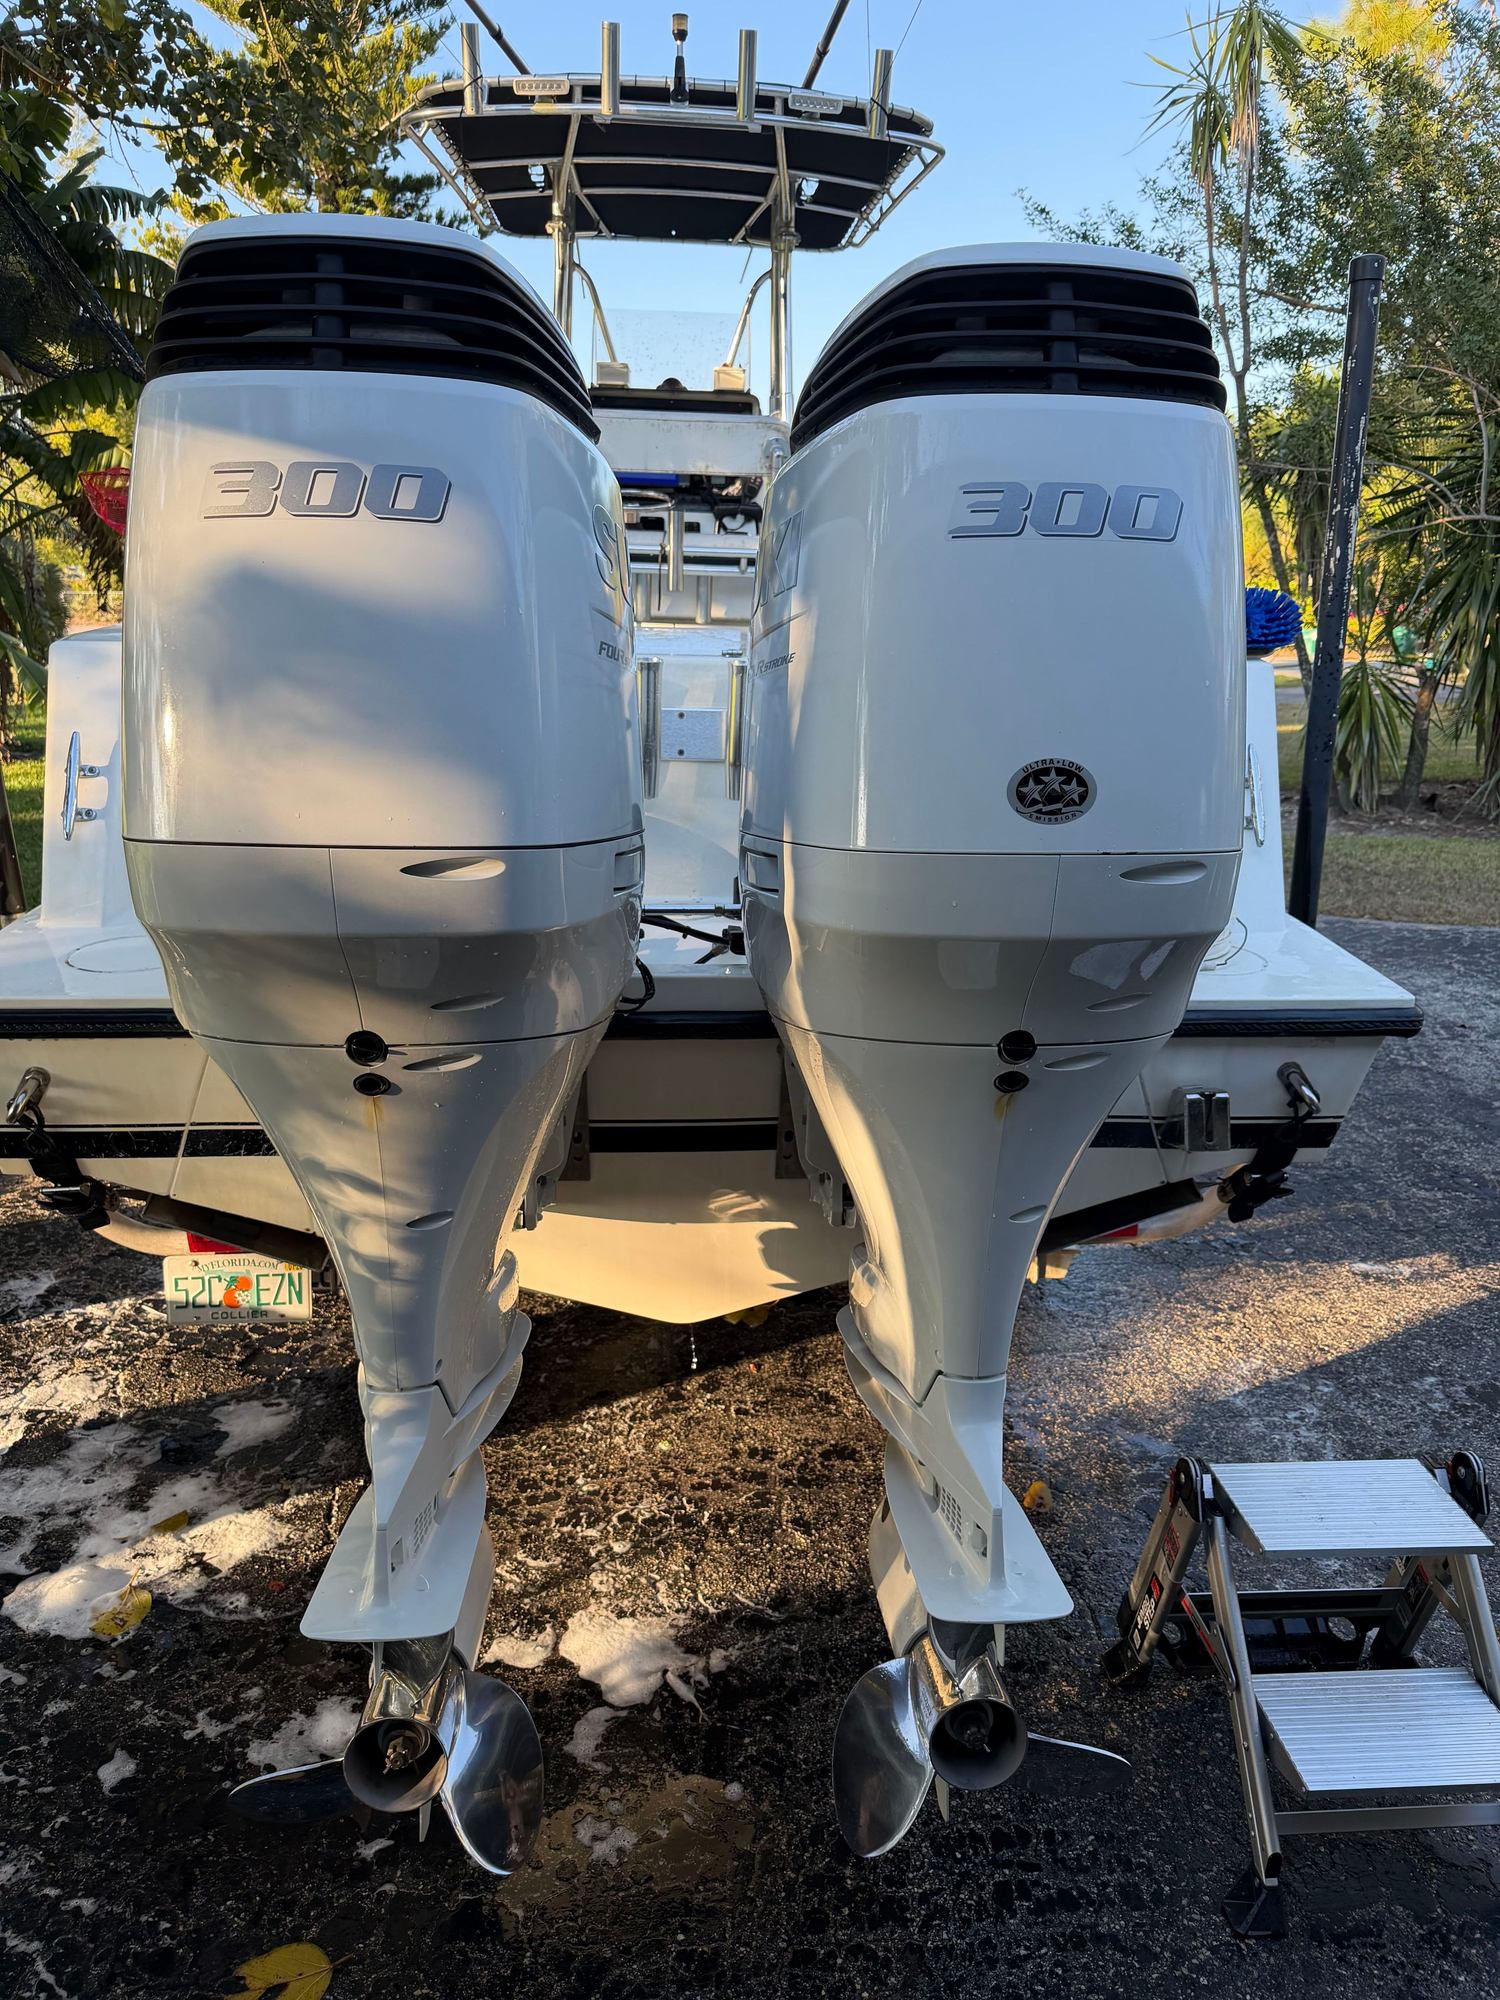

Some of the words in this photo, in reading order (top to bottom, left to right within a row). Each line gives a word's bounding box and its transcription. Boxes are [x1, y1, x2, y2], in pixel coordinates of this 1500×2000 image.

[203, 460, 452, 523] 300
[948, 481, 1185, 542] 300
[1029, 813, 1077, 823] EMISSION
[198, 1258, 279, 1273] MYFLORIDA.COM
[174, 1274, 223, 1309] 52C
[255, 1272, 303, 1307] EZN
[210, 1310, 269, 1320] COLLIER
[1143, 1597, 1156, 1630] STEP
